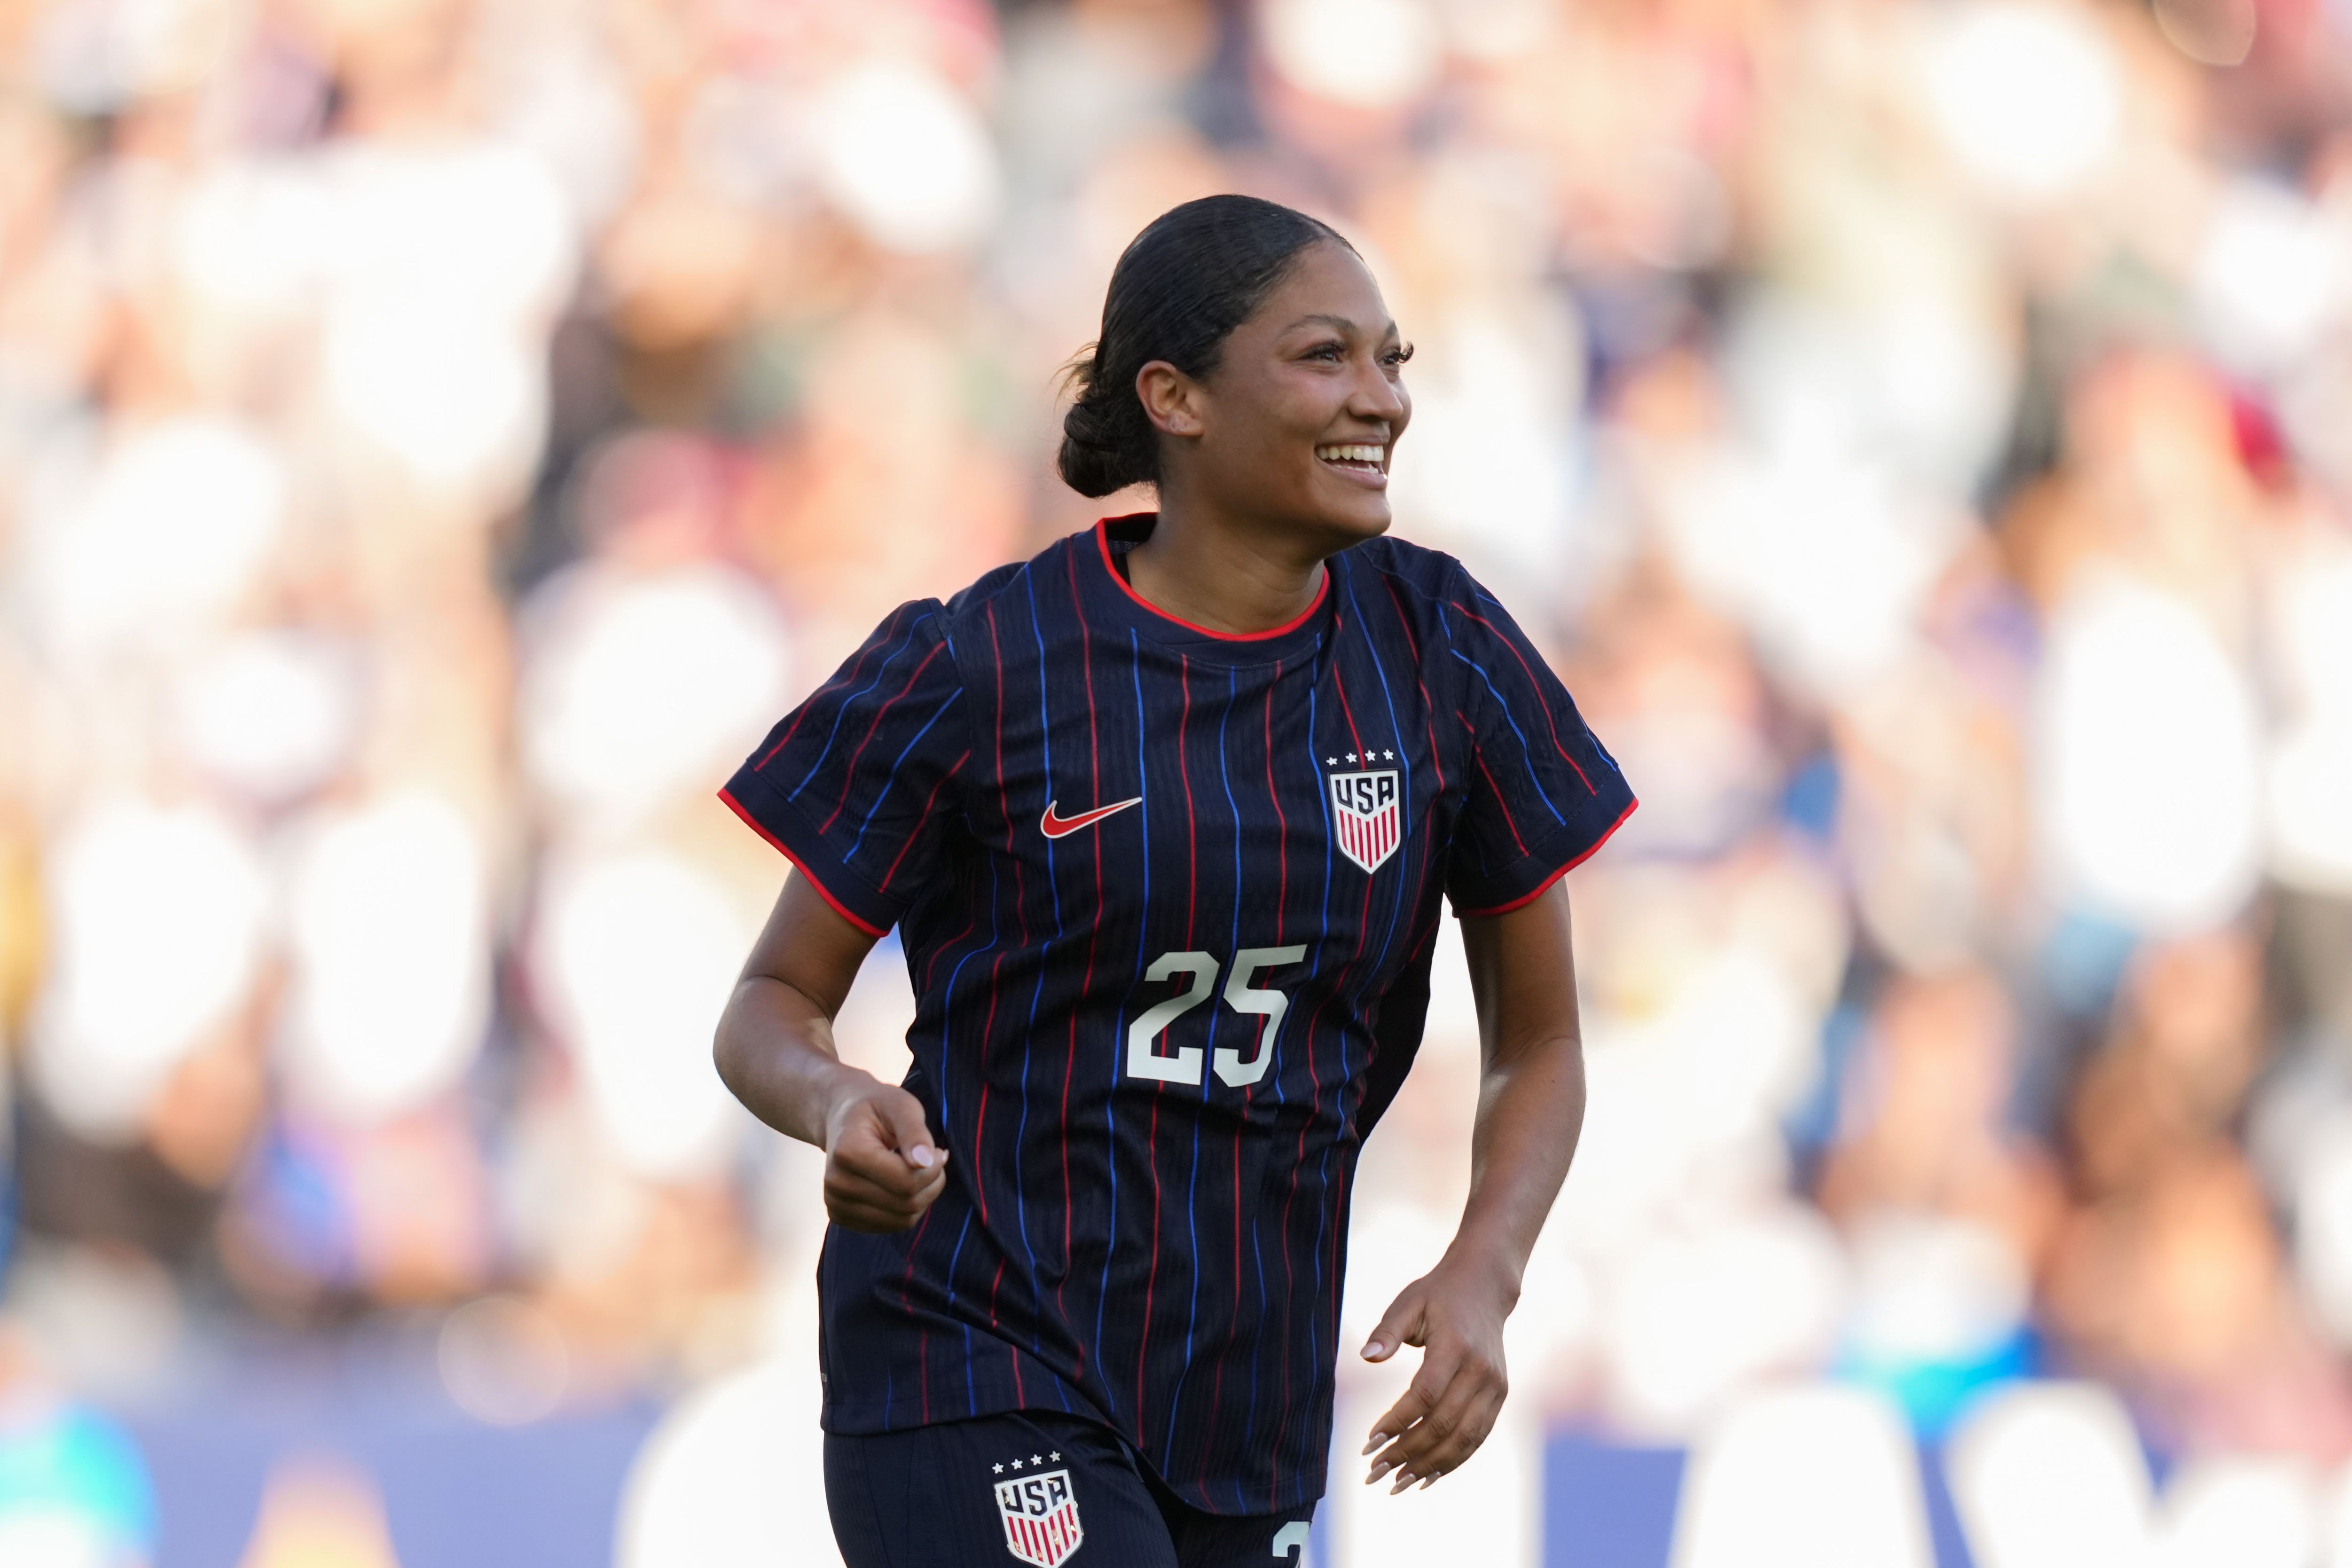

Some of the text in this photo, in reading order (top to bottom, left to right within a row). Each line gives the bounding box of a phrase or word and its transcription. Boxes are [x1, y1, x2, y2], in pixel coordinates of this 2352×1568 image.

[1335, 776, 1394, 815] USA
[1127, 944, 1307, 1087] 25
[1001, 1475, 1067, 1516] USA
